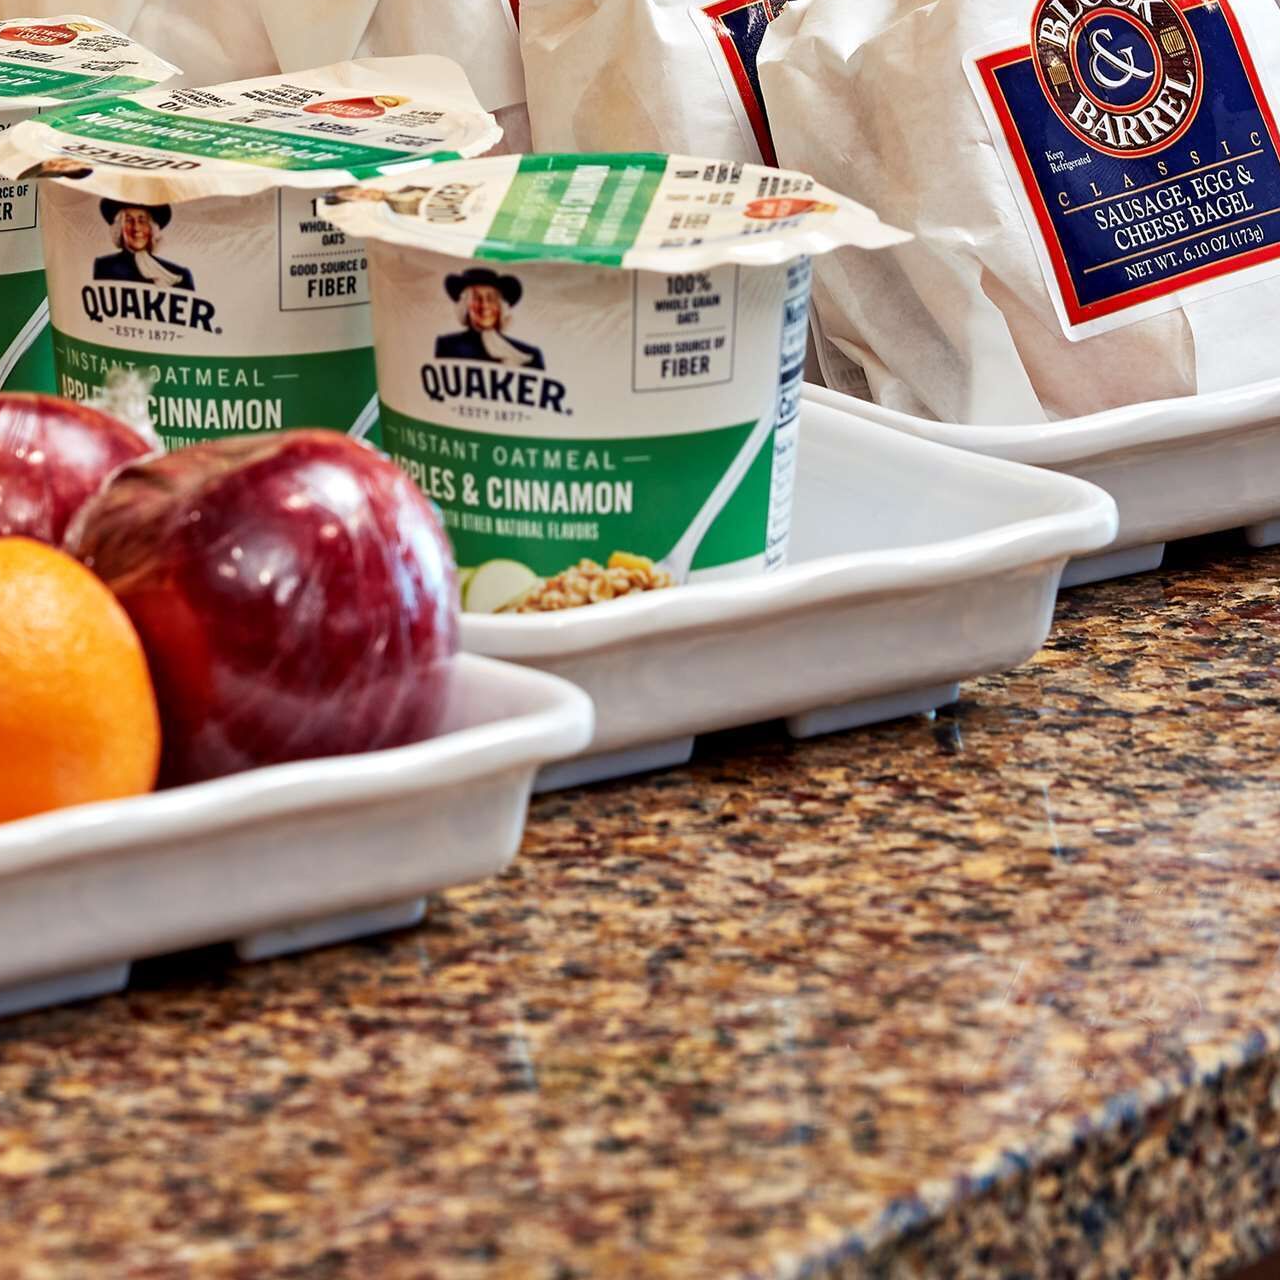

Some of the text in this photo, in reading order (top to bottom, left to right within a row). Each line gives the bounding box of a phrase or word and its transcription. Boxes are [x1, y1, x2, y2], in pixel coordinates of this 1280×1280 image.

[8, 49, 64, 61] FIBER
[1089, 28, 1154, 89] &
[157, 101, 191, 112] NO
[1068, 70, 1195, 147] BARREL
[76, 112, 343, 162] APPLES & CINNAMON
[60, 143, 201, 170] QUAKER
[1045, 149, 1065, 162] Keep
[1049, 153, 1092, 174] Refrigerated
[16, 184, 29, 197] OF
[1094, 164, 1255, 230] SAUSAGE, EGG &
[299, 220, 334, 233] WHOLE
[1114, 190, 1255, 250] CHEESE BAGEL
[322, 233, 346, 246] OATS
[1126, 225, 1264, 281] NET WT. 6.10 OZ (173g)
[290, 258, 358, 276] GOOD SOURCE
[307, 275, 357, 299] FIBER
[666, 272, 712, 295] 100%
[81, 285, 216, 334] QUAKER
[654, 294, 721, 311] WHOLE GRAIN
[676, 312, 700, 325] OATS
[148, 328, 176, 341] 1877
[644, 336, 725, 356] GOOD SOURCE OF
[148, 365, 265, 387] OATMEAL
[661, 355, 710, 378] FIBER
[421, 363, 567, 416] QUAKER
[61, 374, 282, 430] APPLE CINNAMON
[401, 428, 617, 470] INSTANT OATMEAL
[462, 473, 480, 507] &
[486, 475, 634, 514] CINNAMON
[462, 515, 600, 541] OTHER NATURAL FLAVORS
